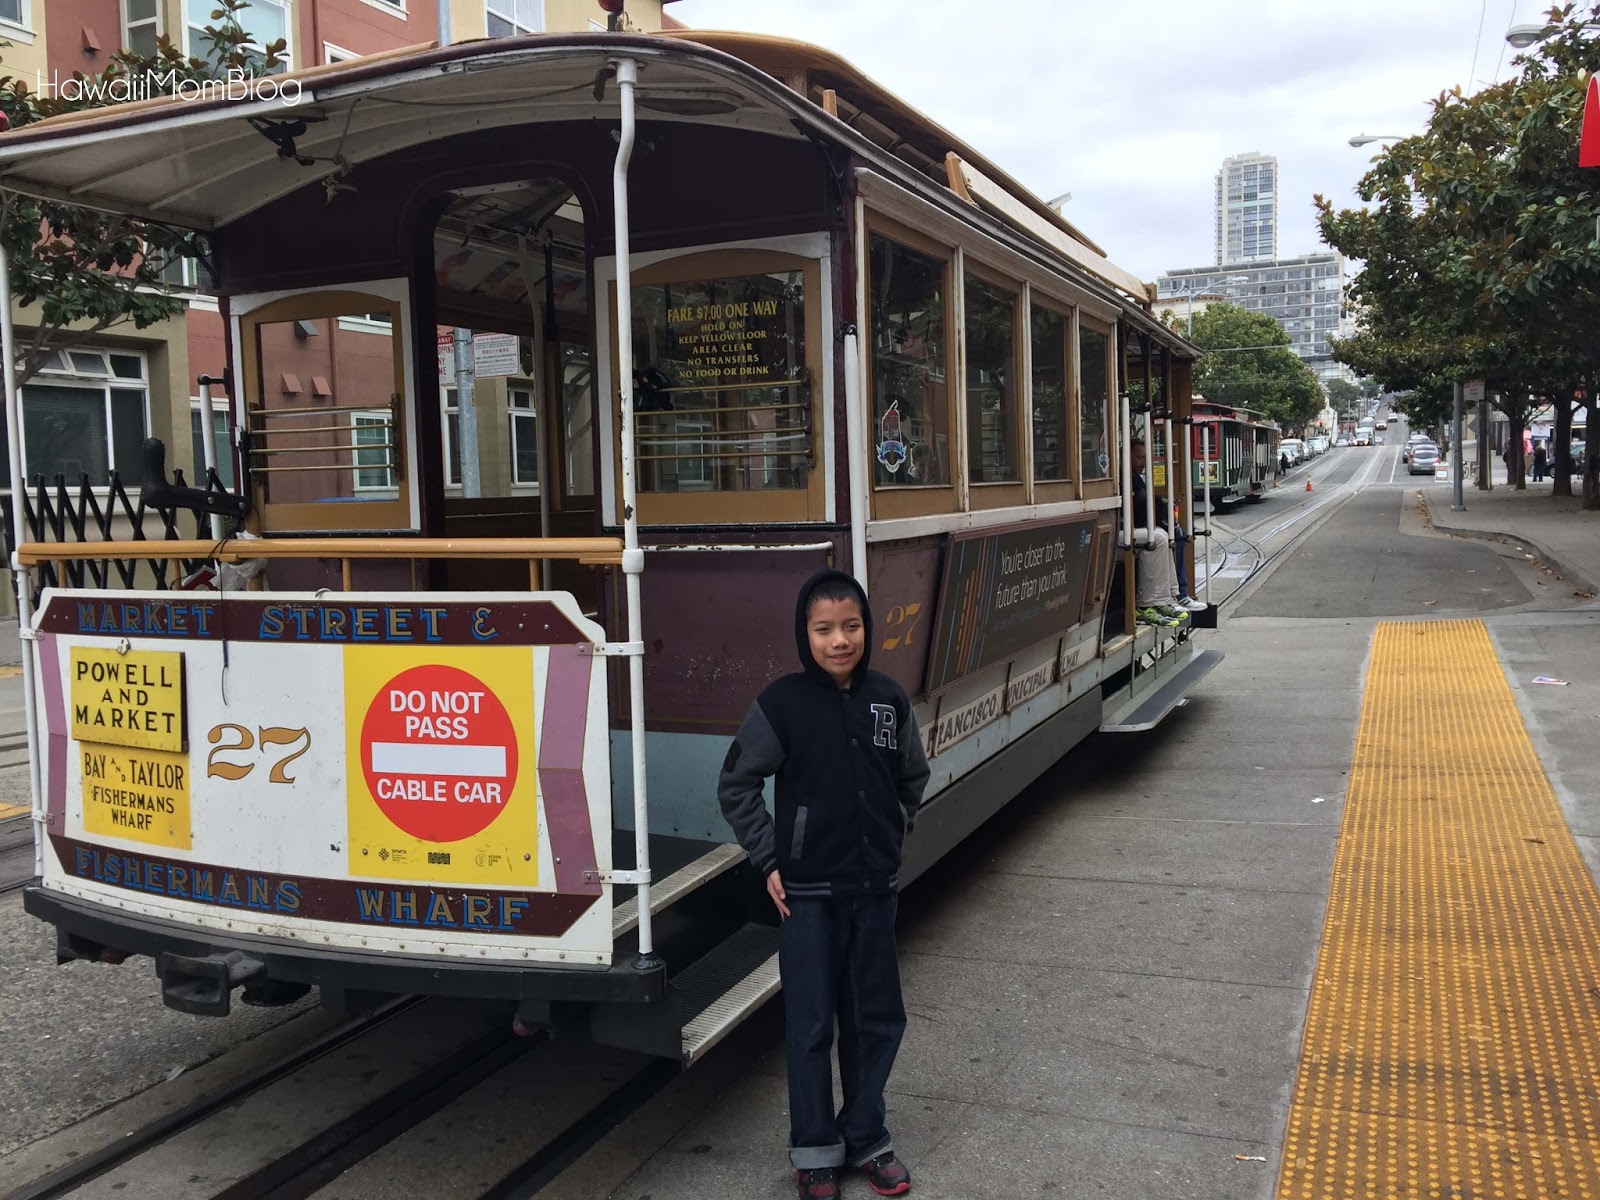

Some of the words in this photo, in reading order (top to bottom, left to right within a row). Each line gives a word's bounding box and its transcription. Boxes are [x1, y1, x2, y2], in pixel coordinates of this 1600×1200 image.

[667, 308, 693, 323] FARE
[696, 304, 722, 321] $7.00
[725, 303, 750, 319] ONE
[753, 300, 778, 316] WAY
[678, 336, 699, 345] KEEP
[701, 333, 736, 343] YELLOW
[736, 331, 767, 341] FLOOR
[701, 322, 726, 332] HOLD
[728, 321, 744, 331] ON
[687, 358, 702, 367] NO
[705, 354, 760, 366] TRANSFERS
[692, 346, 718, 355] AREA
[721, 344, 753, 353] CLEAR
[679, 370, 693, 379] NO
[695, 368, 722, 378] FOOD
[724, 367, 737, 377] OR
[739, 366, 770, 376] DRINK
[1023, 543, 1046, 570] closer
[1045, 541, 1054, 563] to
[1053, 536, 1066, 561] the
[995, 582, 1021, 610] future
[1020, 574, 1038, 601] than
[1035, 574, 1052, 601] you
[1051, 561, 1068, 589] think
[76, 602, 215, 635] MARKET
[259, 604, 448, 642] STREET
[882, 602, 923, 651] 27
[76, 660, 174, 688] POWELL
[101, 688, 149, 707] AND
[389, 689, 426, 714] DO
[430, 691, 485, 715] NOT
[75, 704, 176, 734] MARKET
[404, 715, 469, 740] PASS
[871, 703, 898, 750] R
[926, 692, 997, 752] FRANCISCO
[206, 722, 312, 785] 27
[84, 752, 108, 779] BAY
[129, 758, 185, 791] TAYLOR
[92, 786, 175, 815] FISHERMANS
[376, 777, 447, 803] CABLE
[453, 780, 502, 805] CAR
[111, 811, 154, 831] WHARF
[75, 846, 302, 913] FISHERMANS
[355, 887, 530, 931] WHARF
